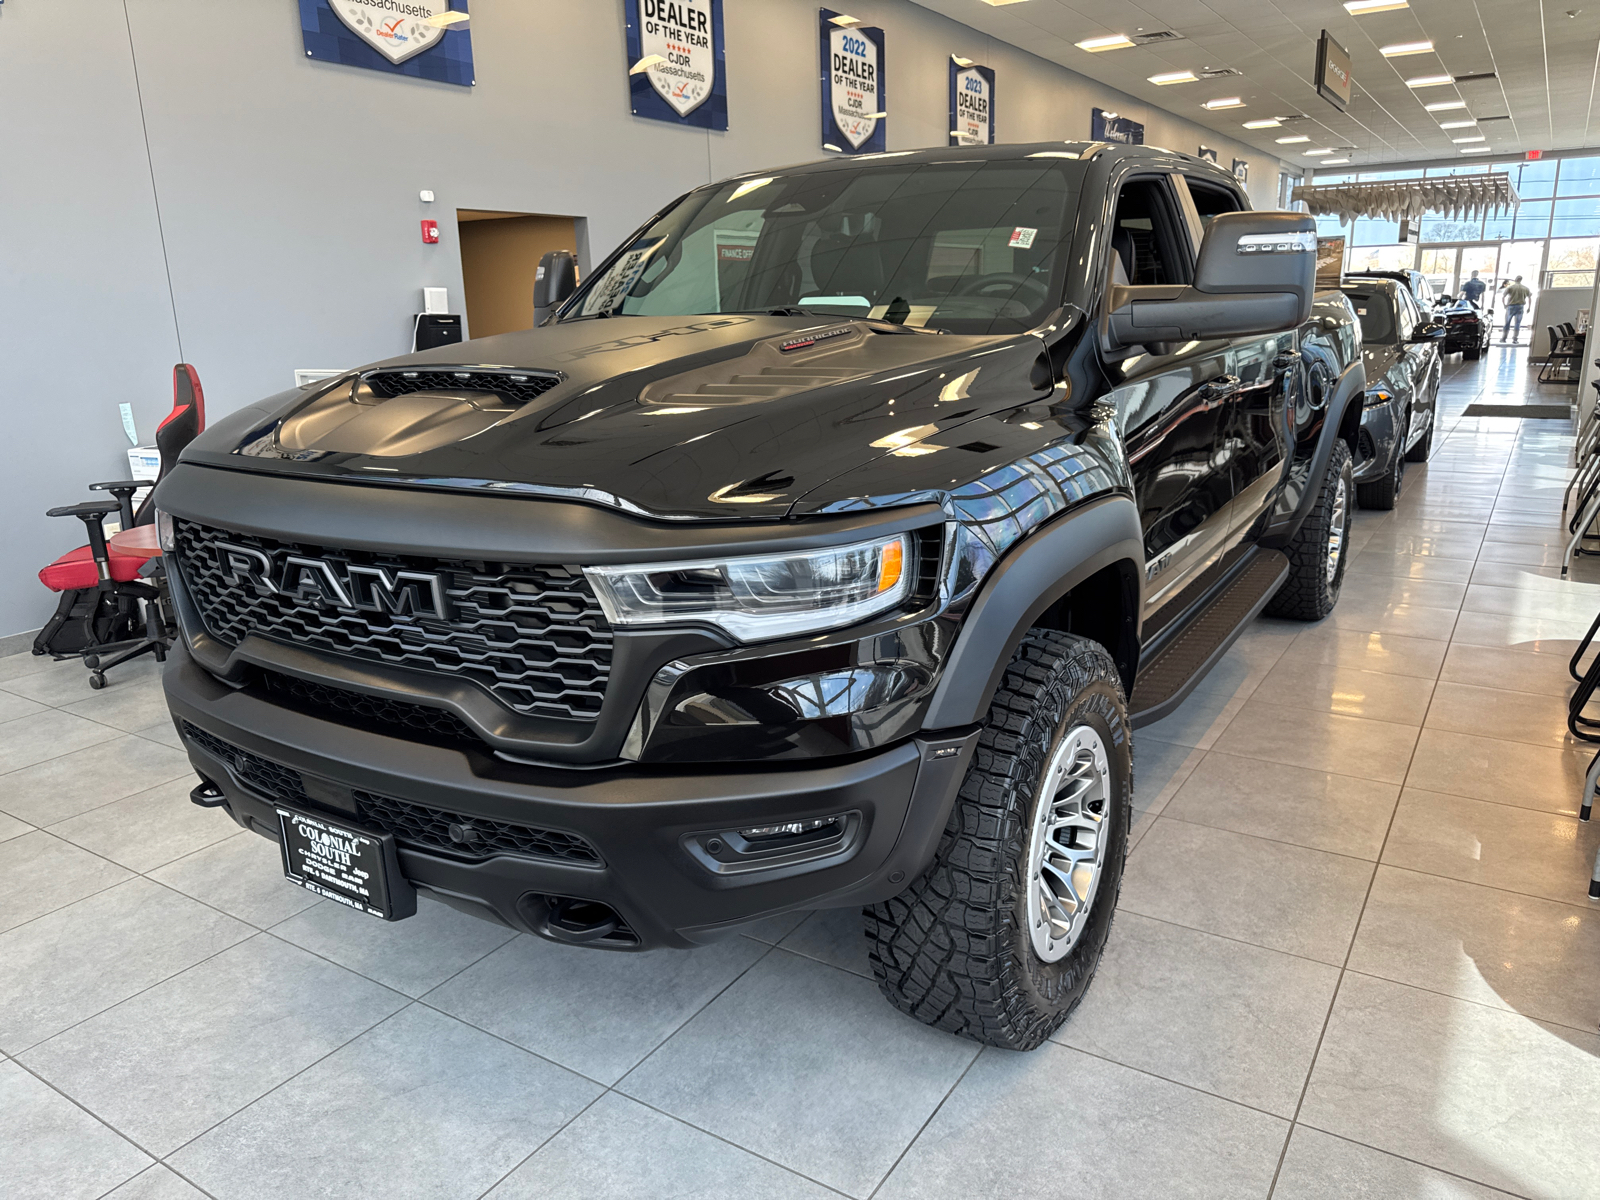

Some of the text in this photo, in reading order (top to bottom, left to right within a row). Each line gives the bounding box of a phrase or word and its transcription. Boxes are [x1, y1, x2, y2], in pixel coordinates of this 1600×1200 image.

[645, 0, 708, 34] DEALER
[646, 21, 709, 49] OF THE YEAR
[842, 35, 866, 58] 2022
[668, 52, 691, 68] CJDR
[834, 53, 875, 83] DEALER
[834, 74, 875, 94] OF THE YEAR
[965, 76, 982, 94] 2023
[959, 92, 987, 115] DEALER
[959, 109, 987, 124] OF THE YEAR
[214, 541, 448, 620] RAM
[298, 824, 361, 857] COLONIAL
[298, 848, 347, 871] CHRYSLER
[311, 841, 351, 866] SOUTH
[305, 858, 336, 875] DODGE
[341, 873, 363, 885] RAM
[359, 887, 369, 897] MA
[354, 902, 363, 910] MA
